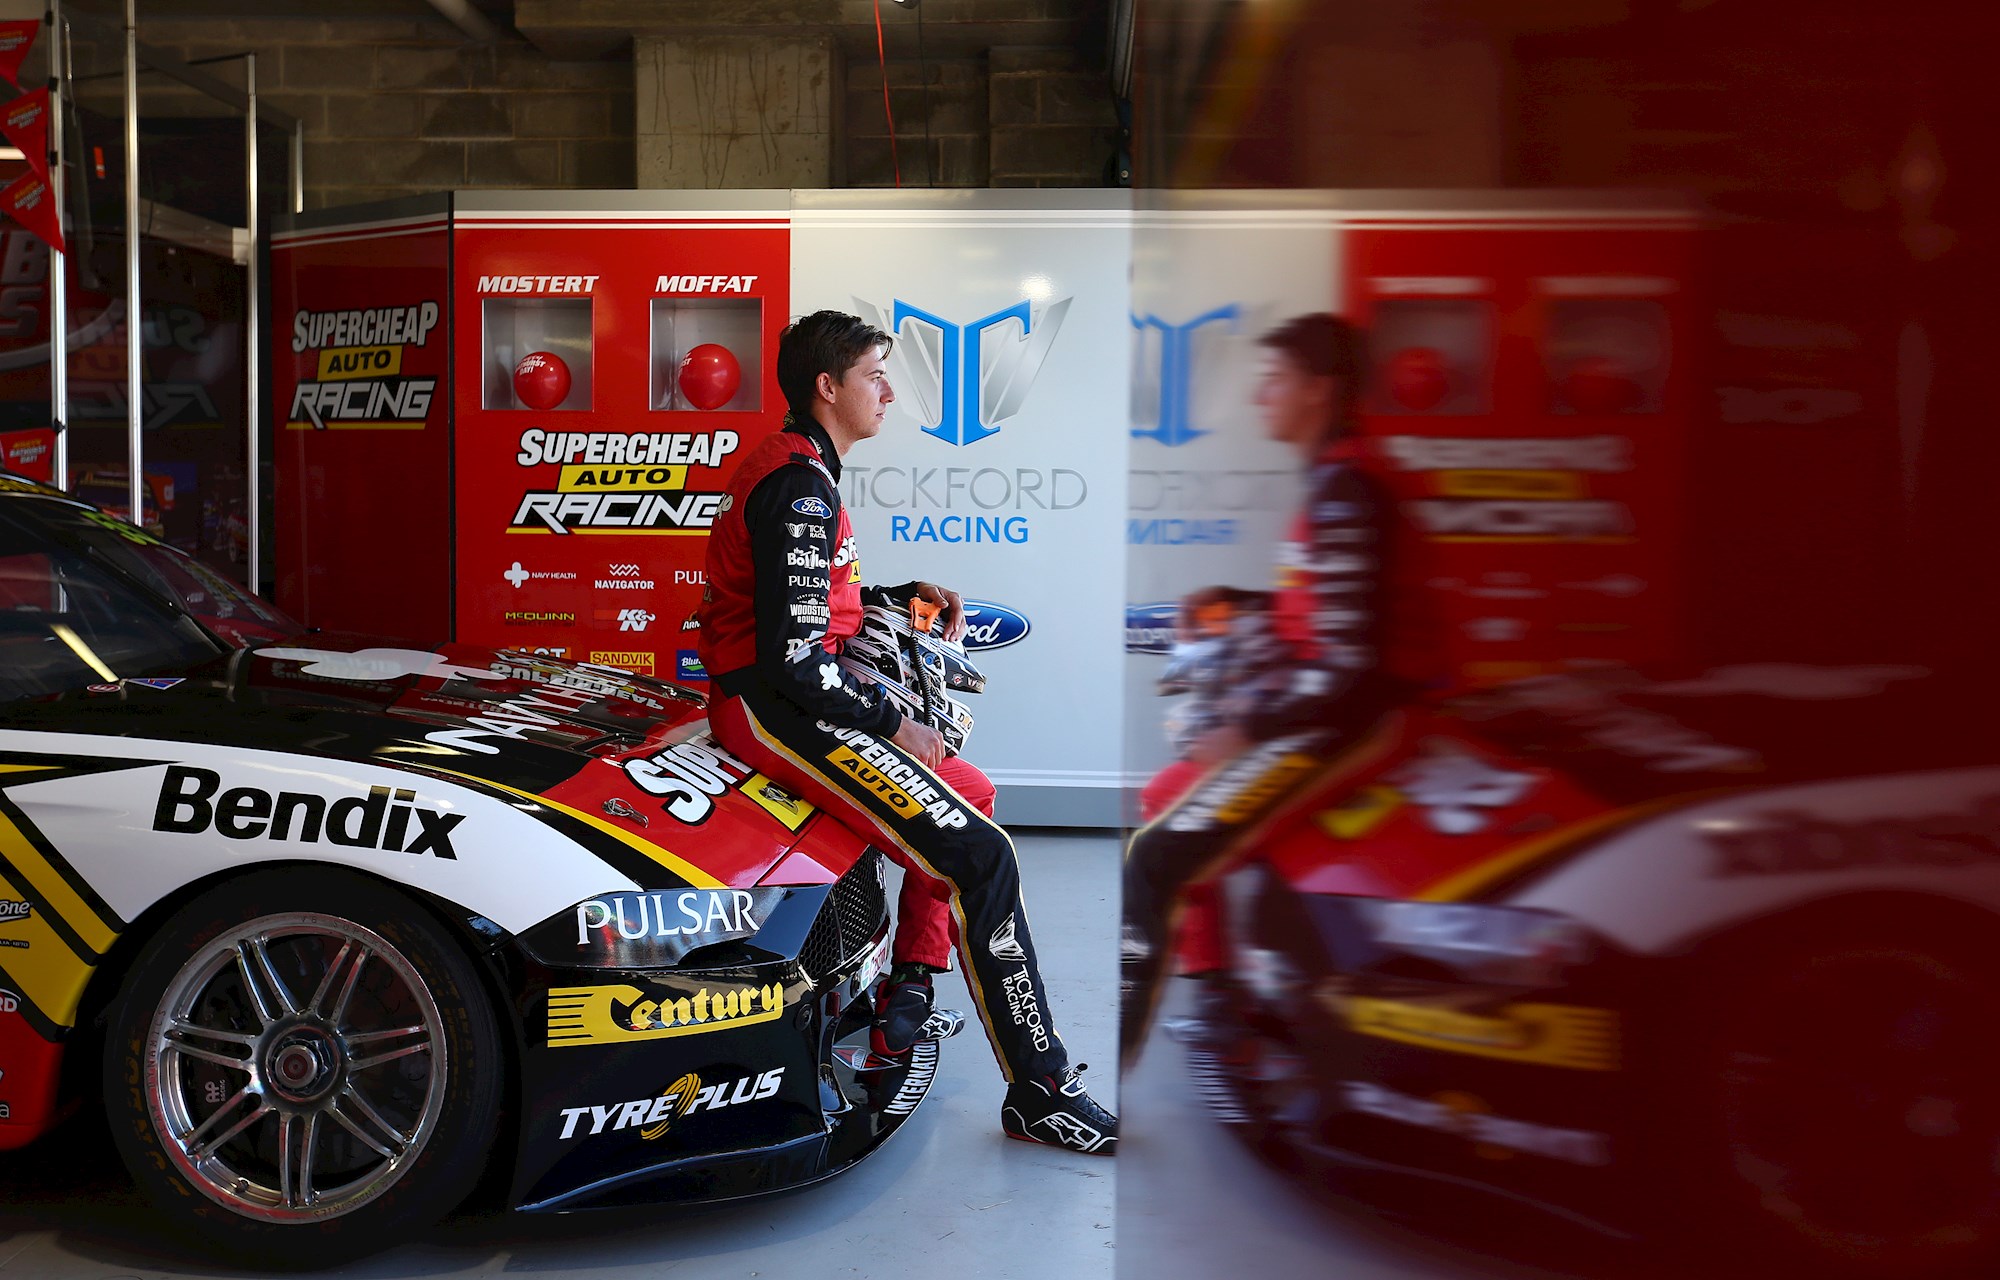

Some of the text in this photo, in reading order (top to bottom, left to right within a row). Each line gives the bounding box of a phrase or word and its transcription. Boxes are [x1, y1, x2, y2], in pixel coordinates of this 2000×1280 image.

[477, 275, 599, 293] MOSTERT
[655, 275, 757, 293] MOFFAT
[292, 302, 438, 352] SUPERCHEAP
[327, 349, 392, 374] AUTO
[289, 380, 435, 430] RACING
[517, 429, 738, 467] SUPERCHEAP
[573, 468, 671, 486] AUTO
[846, 465, 1087, 510] TICKFORD
[891, 514, 1029, 544] RACING
[532, 571, 577, 580] NAVY HEALTH
[594, 579, 654, 589] NAVIGATOR
[797, 615, 827, 625] BOURBON
[592, 653, 652, 666] SANDVIK
[842, 683, 858, 700] NAVY
[815, 717, 968, 831] SUPERCHEAP
[840, 757, 911, 810] AUTO
[152, 765, 467, 860] Bendix
[577, 890, 760, 946] PULSAR
[548, 982, 784, 1048] Century
[1002, 976, 1024, 1026] RACING
[1012, 964, 1050, 1053] TICKFORD
